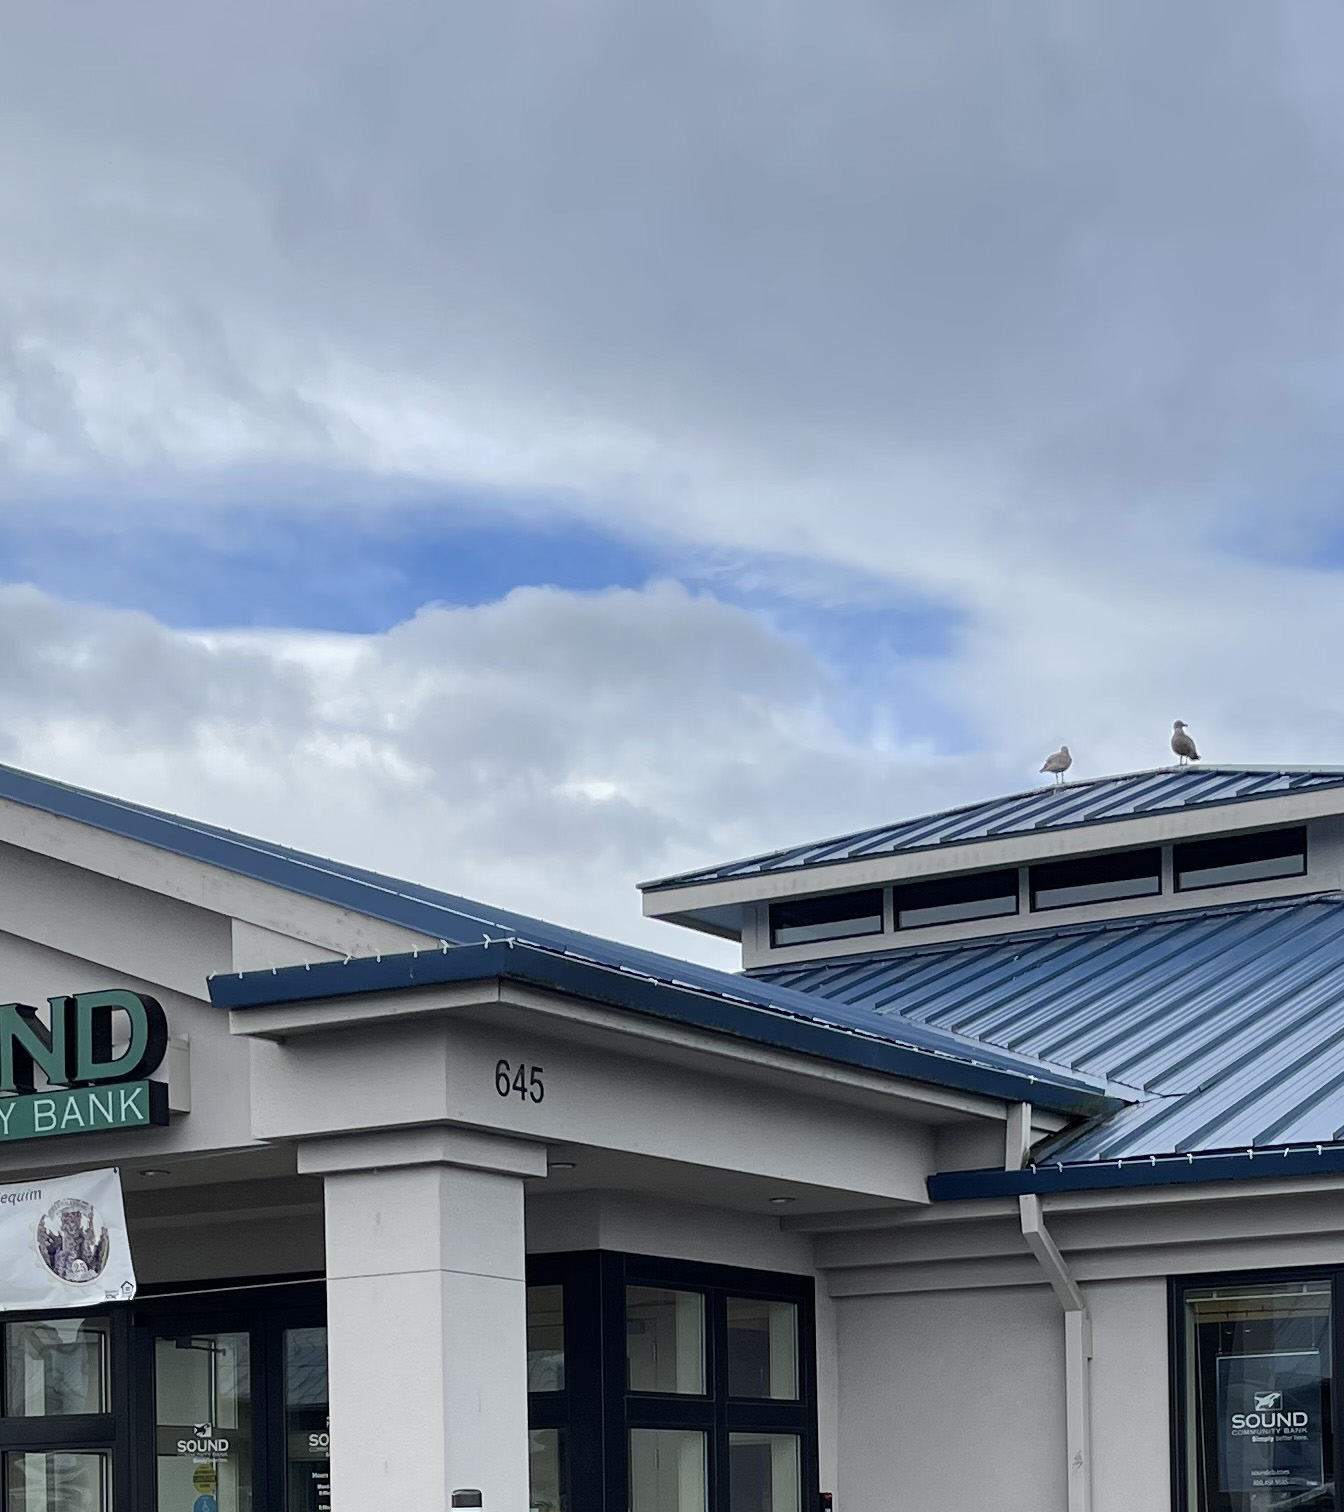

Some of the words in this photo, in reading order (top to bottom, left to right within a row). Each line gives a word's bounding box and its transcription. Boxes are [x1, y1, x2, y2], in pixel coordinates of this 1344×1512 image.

[496, 1060, 544, 1103] 645
[33, 1087, 145, 1133] BANK
[1231, 1411, 1309, 1429] SOUND
[1231, 1428, 1281, 1436] COMMUNITY
[177, 1439, 229, 1453] SOUND
